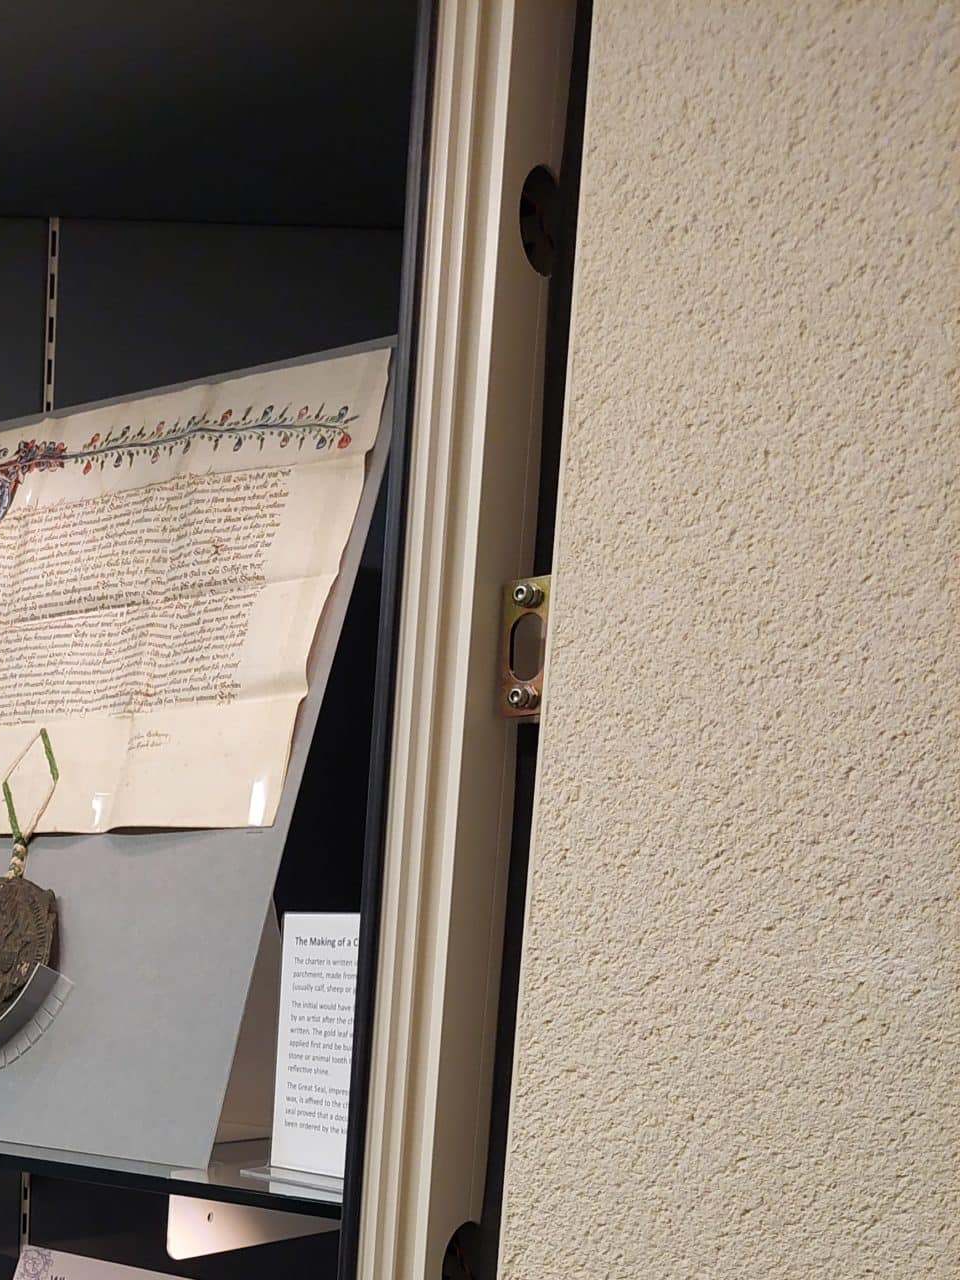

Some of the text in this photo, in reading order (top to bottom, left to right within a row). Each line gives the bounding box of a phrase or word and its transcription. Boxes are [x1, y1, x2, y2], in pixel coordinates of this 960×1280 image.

[295, 936, 308, 946] The
[309, 936, 336, 948] Making
[337, 937, 346, 946] of
